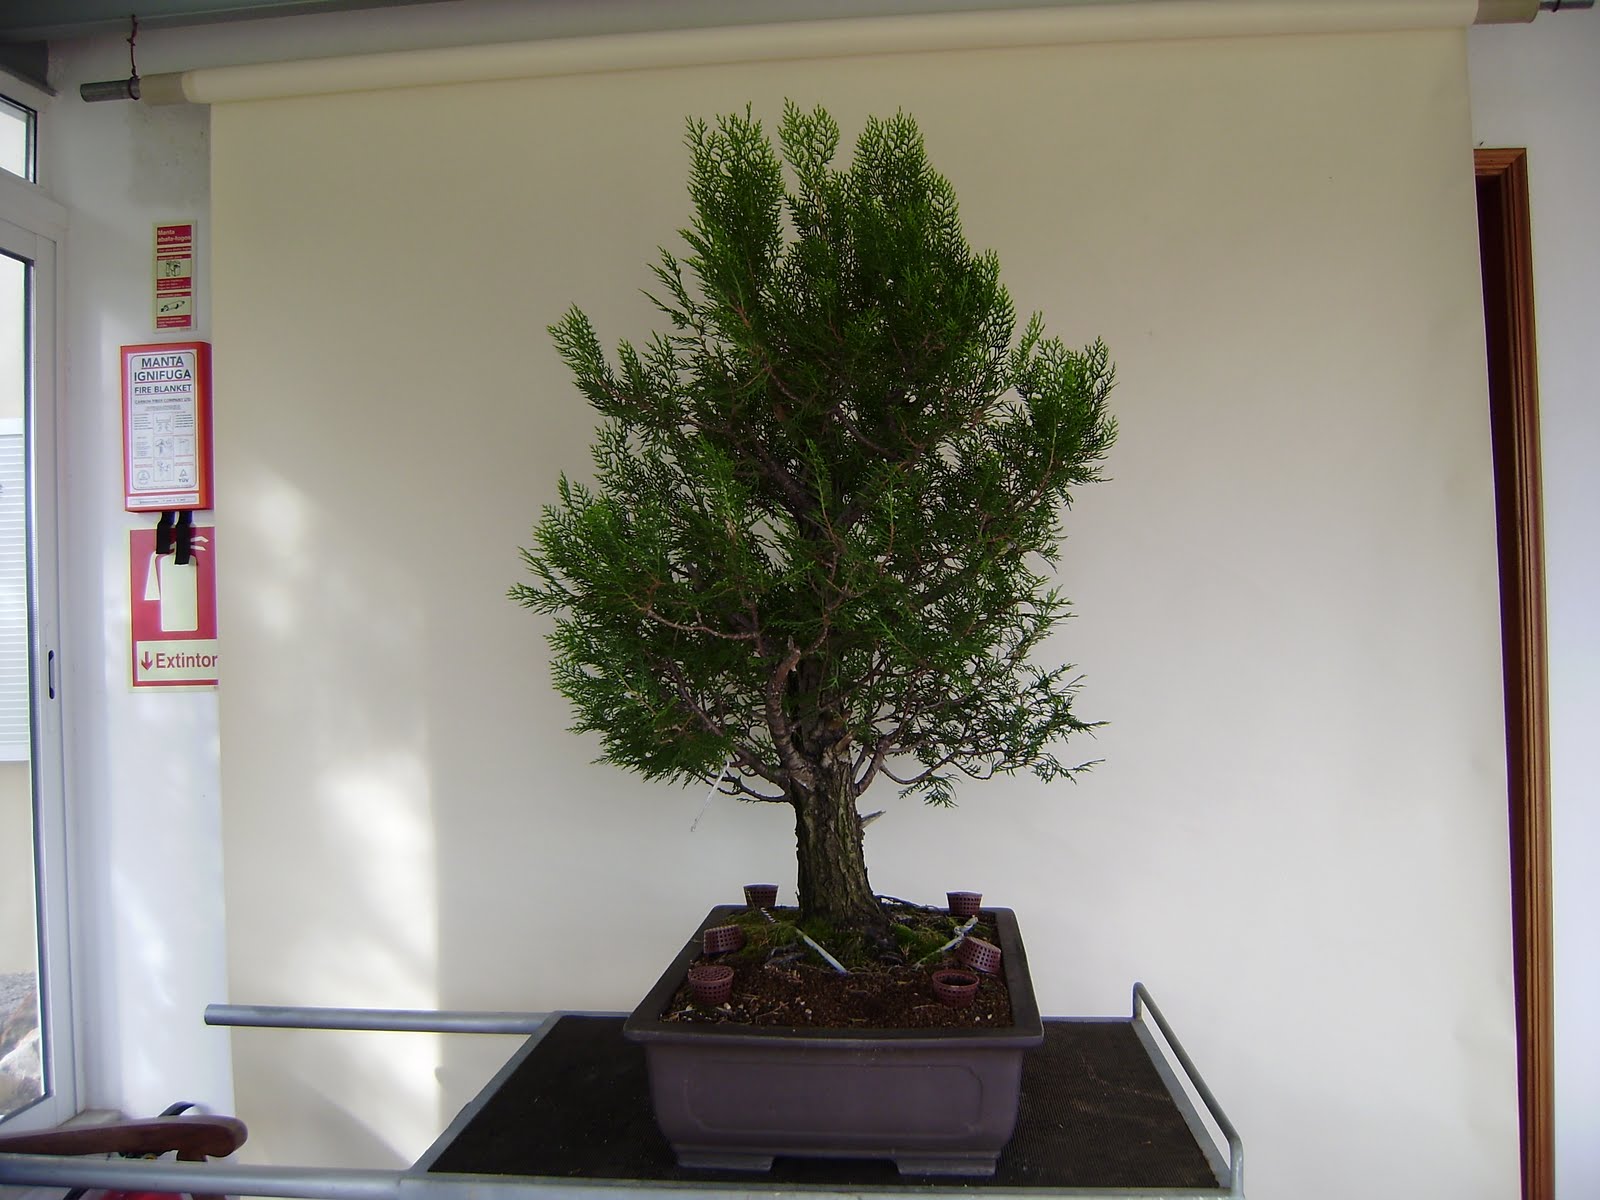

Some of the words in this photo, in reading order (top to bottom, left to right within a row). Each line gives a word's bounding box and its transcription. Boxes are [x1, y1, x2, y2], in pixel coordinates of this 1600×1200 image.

[141, 355, 184, 368] MANTA
[134, 369, 192, 381] IGNIFUGA
[134, 386, 152, 394] FIRE
[154, 384, 192, 393] BLANKET
[156, 652, 218, 669] Extintor
